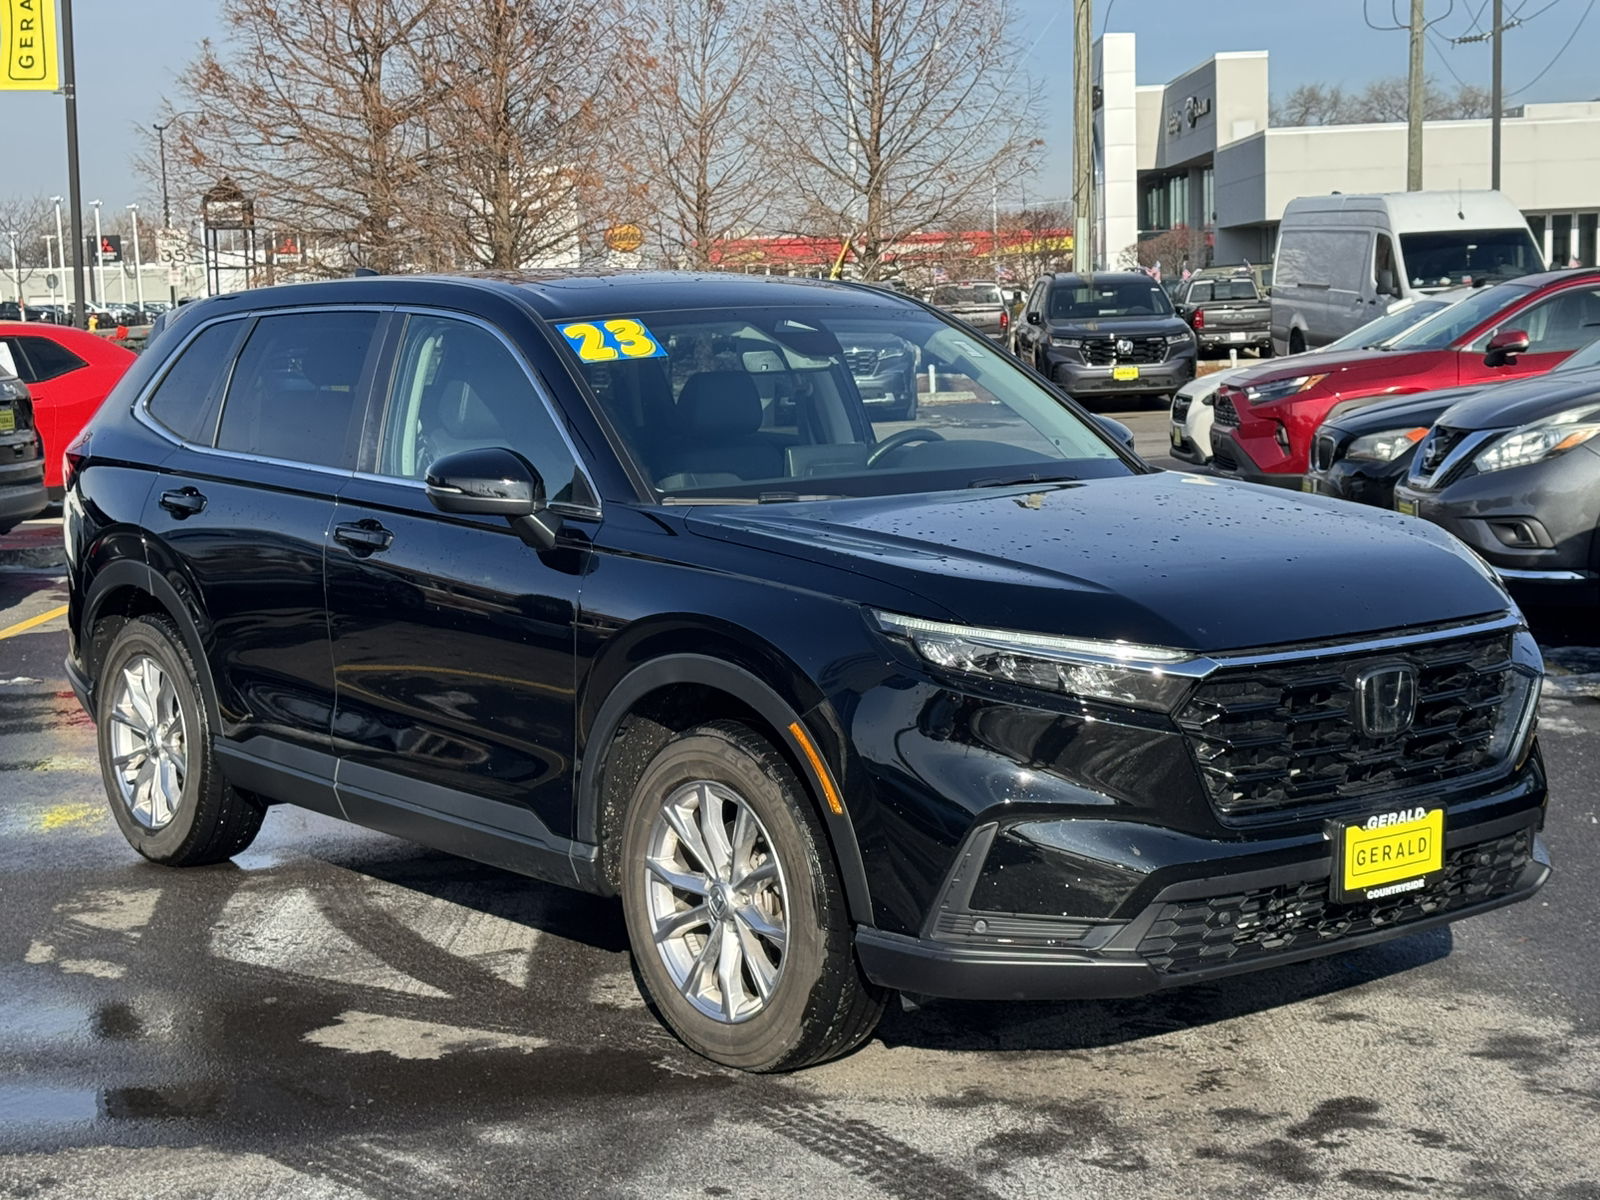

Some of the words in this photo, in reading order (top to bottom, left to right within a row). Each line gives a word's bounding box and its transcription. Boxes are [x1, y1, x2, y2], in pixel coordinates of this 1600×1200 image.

[160, 249, 185, 262] 35
[563, 319, 656, 361] 23
[1366, 807, 1425, 830] GERALD
[1356, 837, 1427, 866] GERALD
[1366, 878, 1425, 899] COUNTRYSIDE
